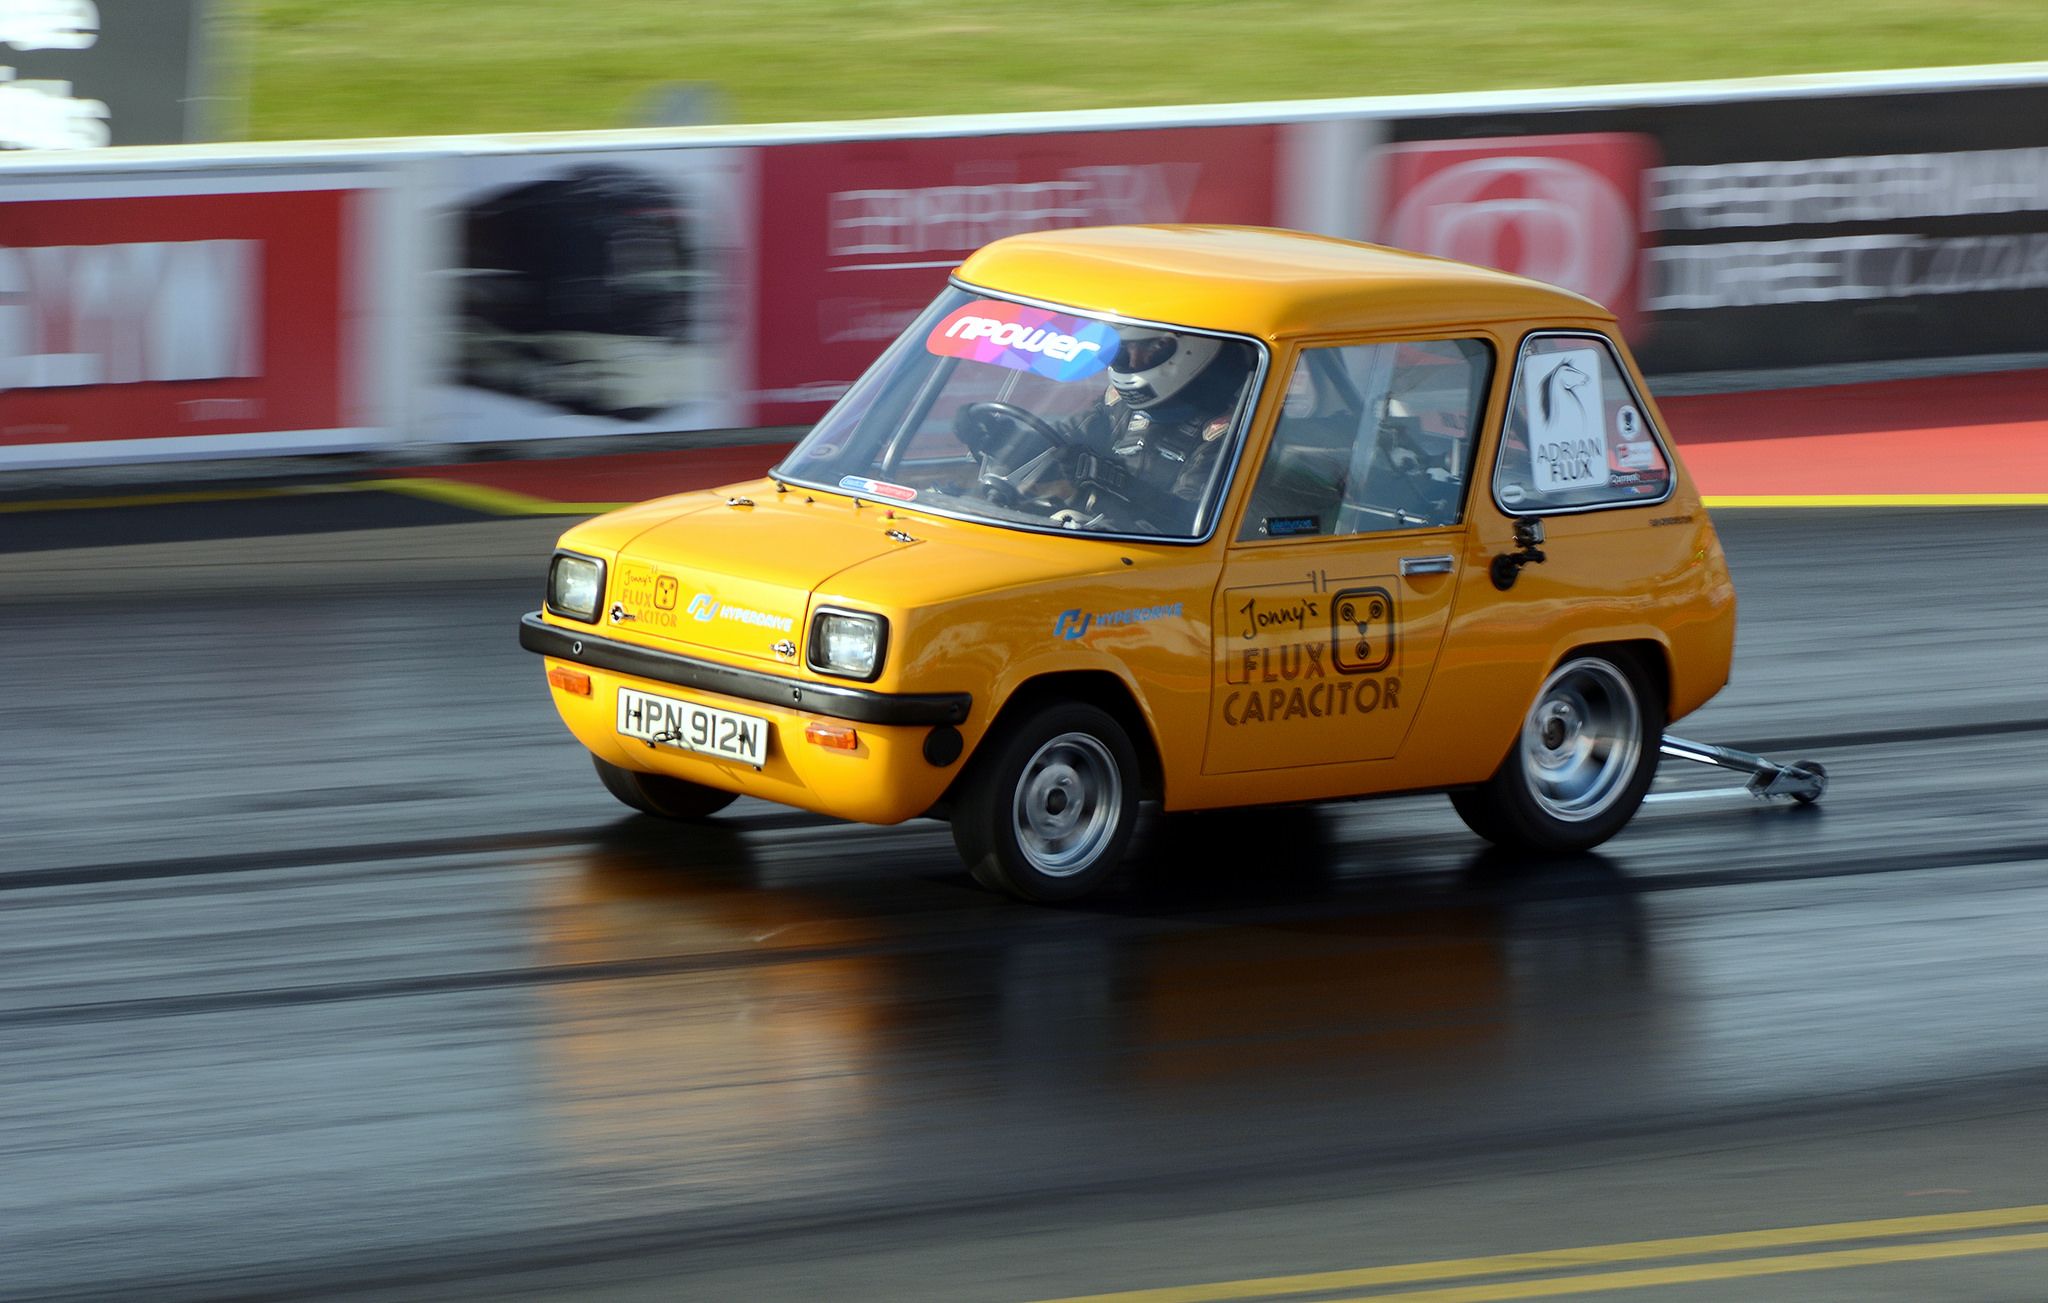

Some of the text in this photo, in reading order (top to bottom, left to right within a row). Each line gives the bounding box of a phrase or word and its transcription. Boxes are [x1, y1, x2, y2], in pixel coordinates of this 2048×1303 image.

[1537, 437, 1603, 464] ADRIAN
[1551, 459, 1594, 482] FLUX
[622, 588, 652, 608] FLUX
[622, 604, 677, 627] ACITOR
[720, 605, 794, 632] HYPERDRIVE
[1096, 602, 1184, 627] HYPERDRIVE
[1239, 598, 1319, 640] Jonny's
[1243, 642, 1325, 684] FLUX
[1223, 676, 1400, 726] CAPACITOR
[625, 695, 758, 758] HPN 912N
